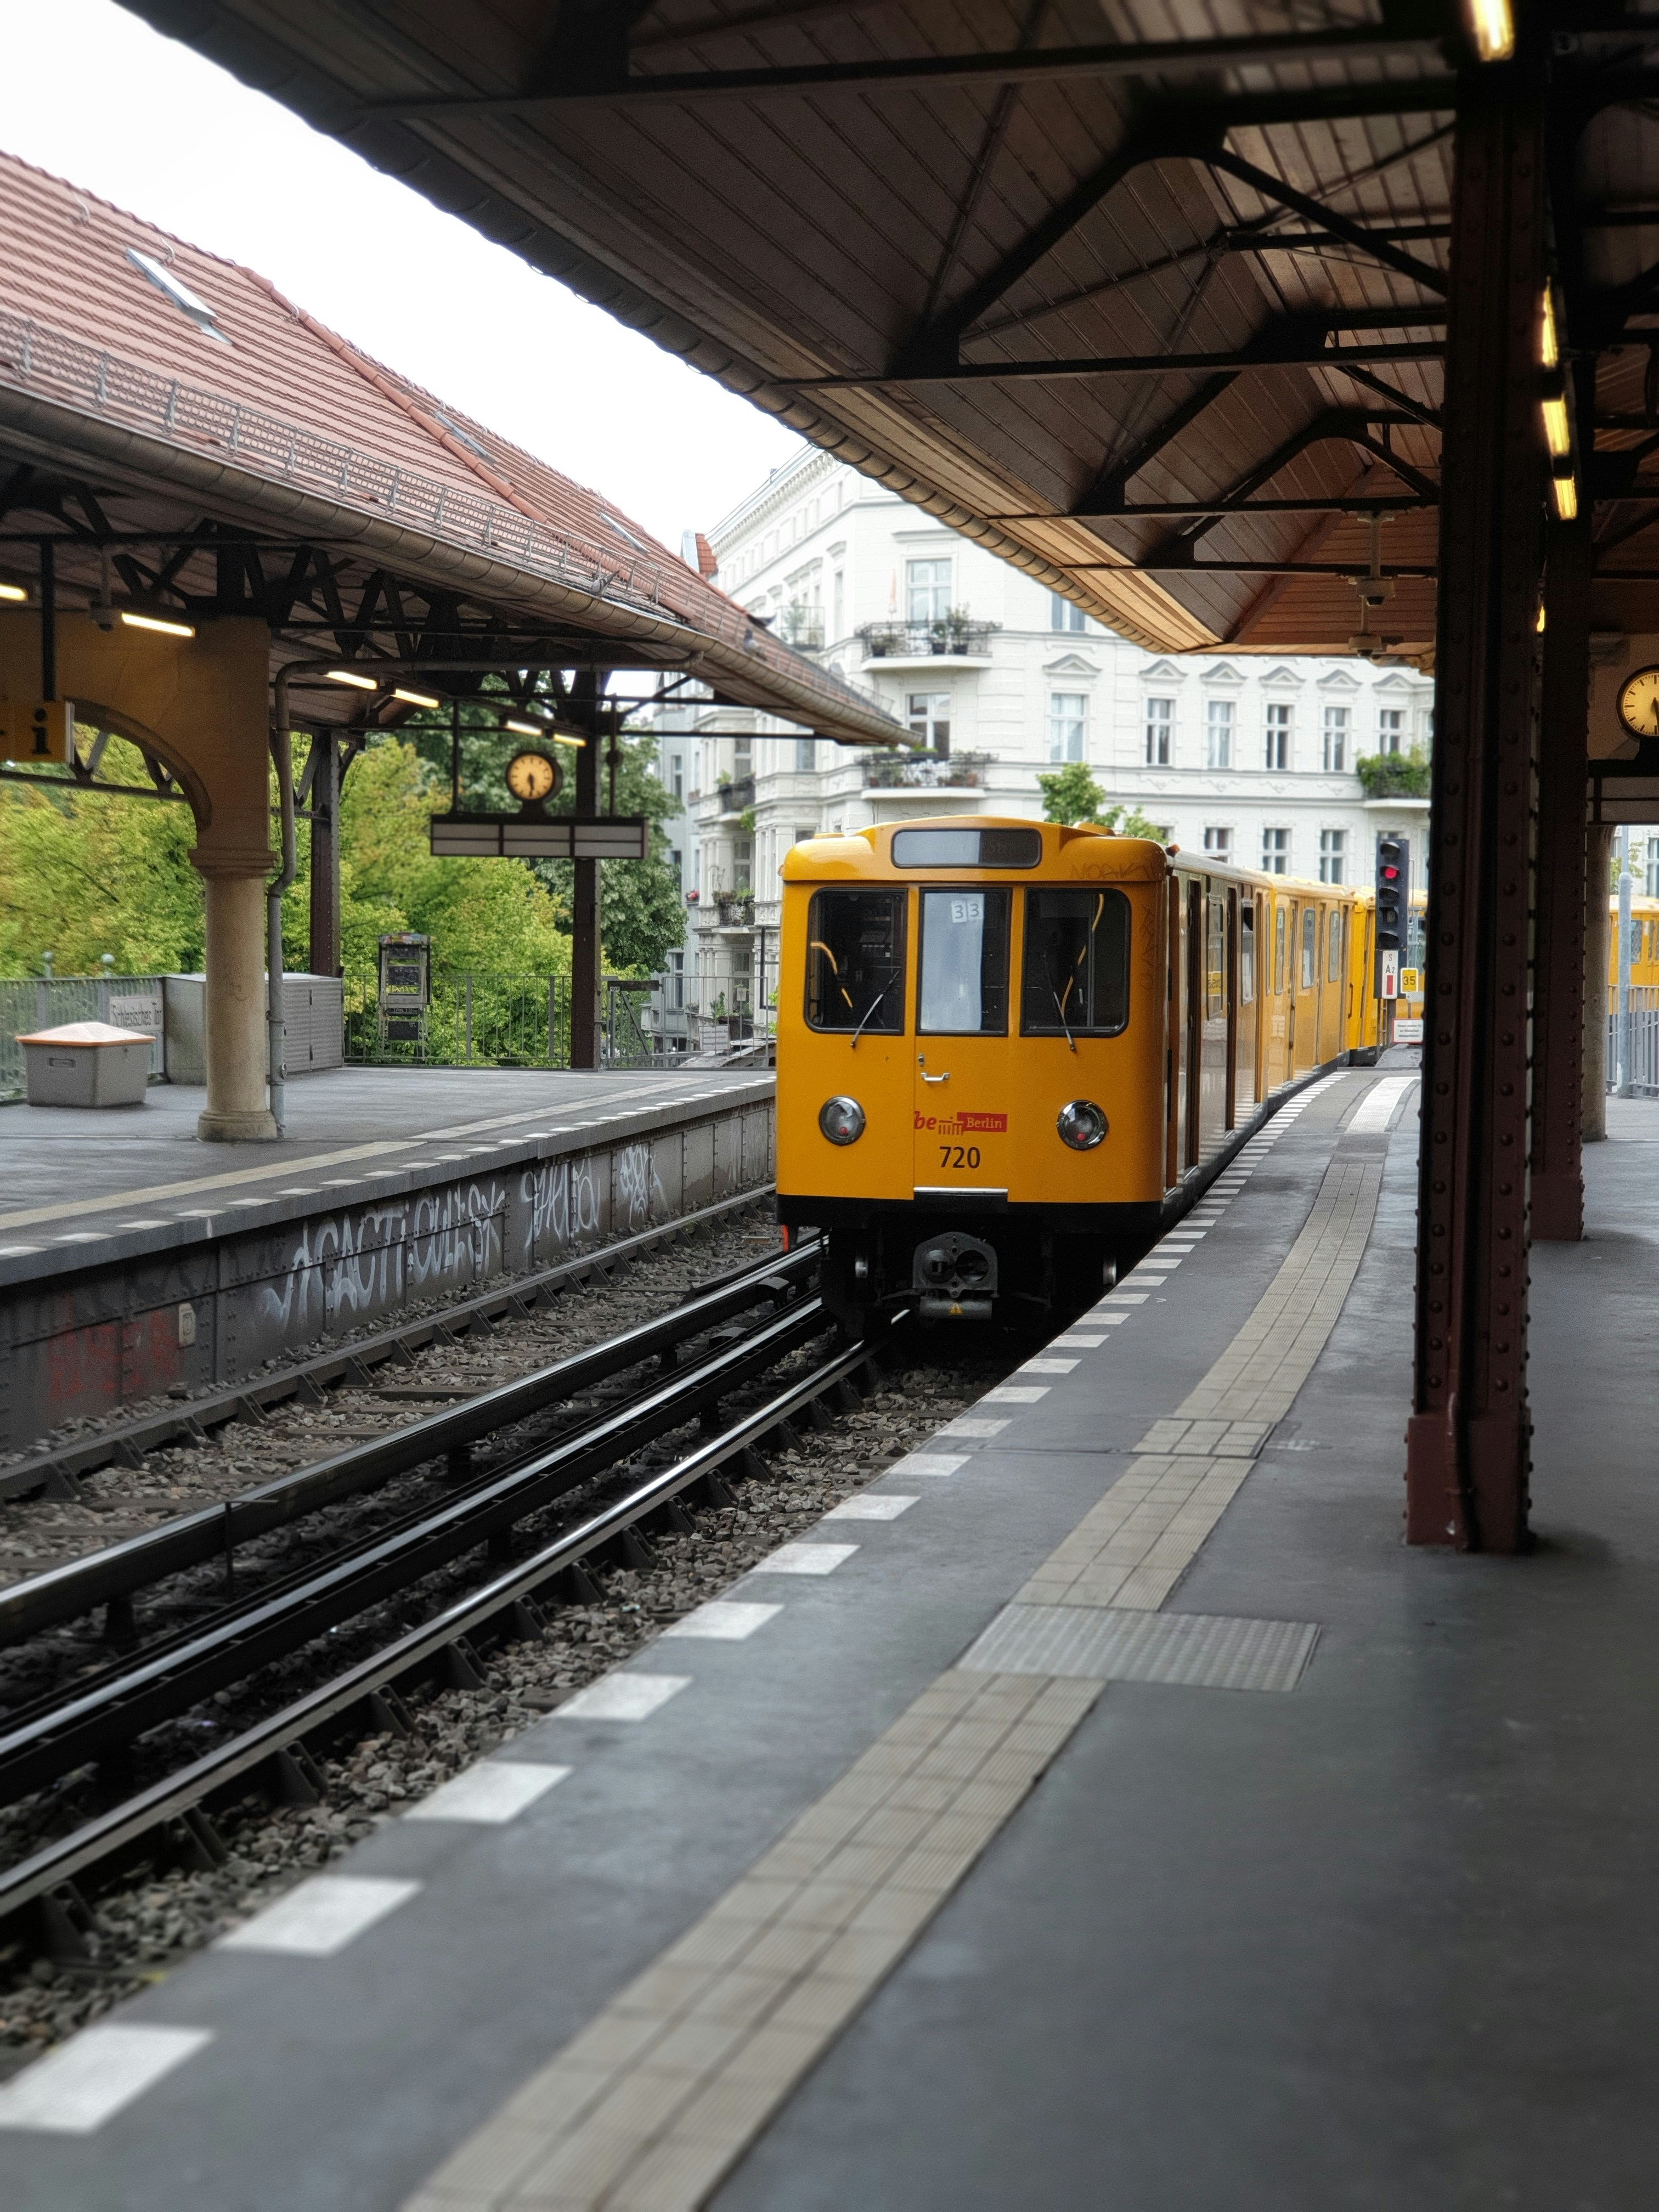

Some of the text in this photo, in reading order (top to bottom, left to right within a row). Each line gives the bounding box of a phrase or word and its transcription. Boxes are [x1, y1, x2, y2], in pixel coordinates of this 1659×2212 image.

[1388, 953, 1393, 962] S
[1403, 975, 1416, 986] 35
[914, 1110, 1002, 1130] be Berlin
[939, 1146, 981, 1169] 720
